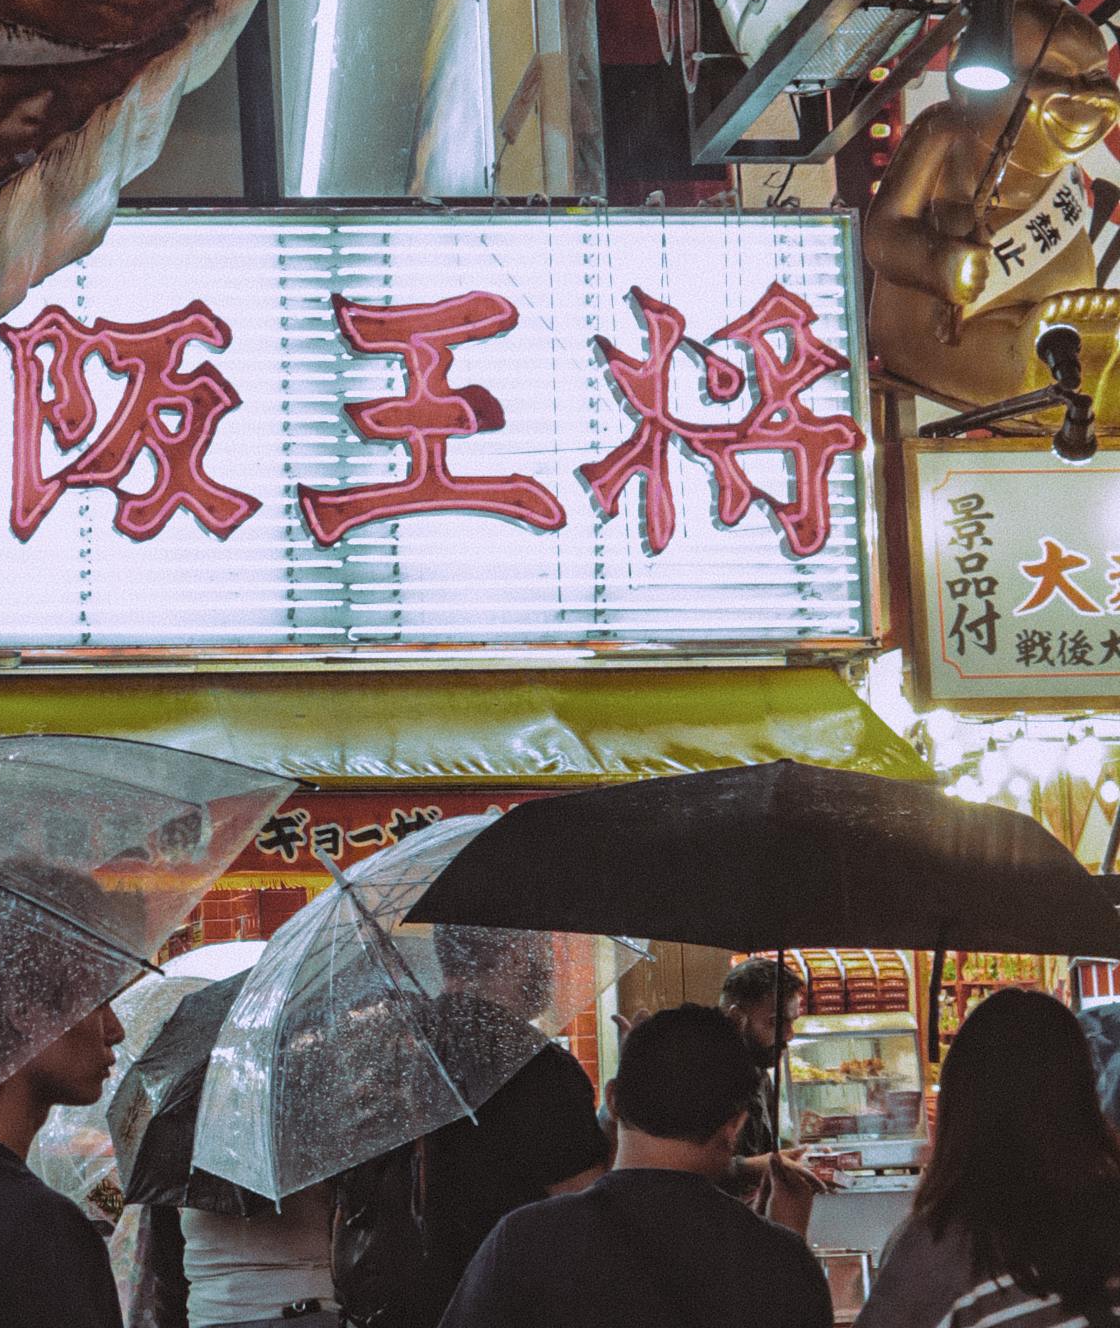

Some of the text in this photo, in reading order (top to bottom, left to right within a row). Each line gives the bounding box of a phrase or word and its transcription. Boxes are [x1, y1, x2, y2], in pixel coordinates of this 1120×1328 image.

[944, 492, 1002, 657] 景品付
[1014, 537, 1120, 615] 大
